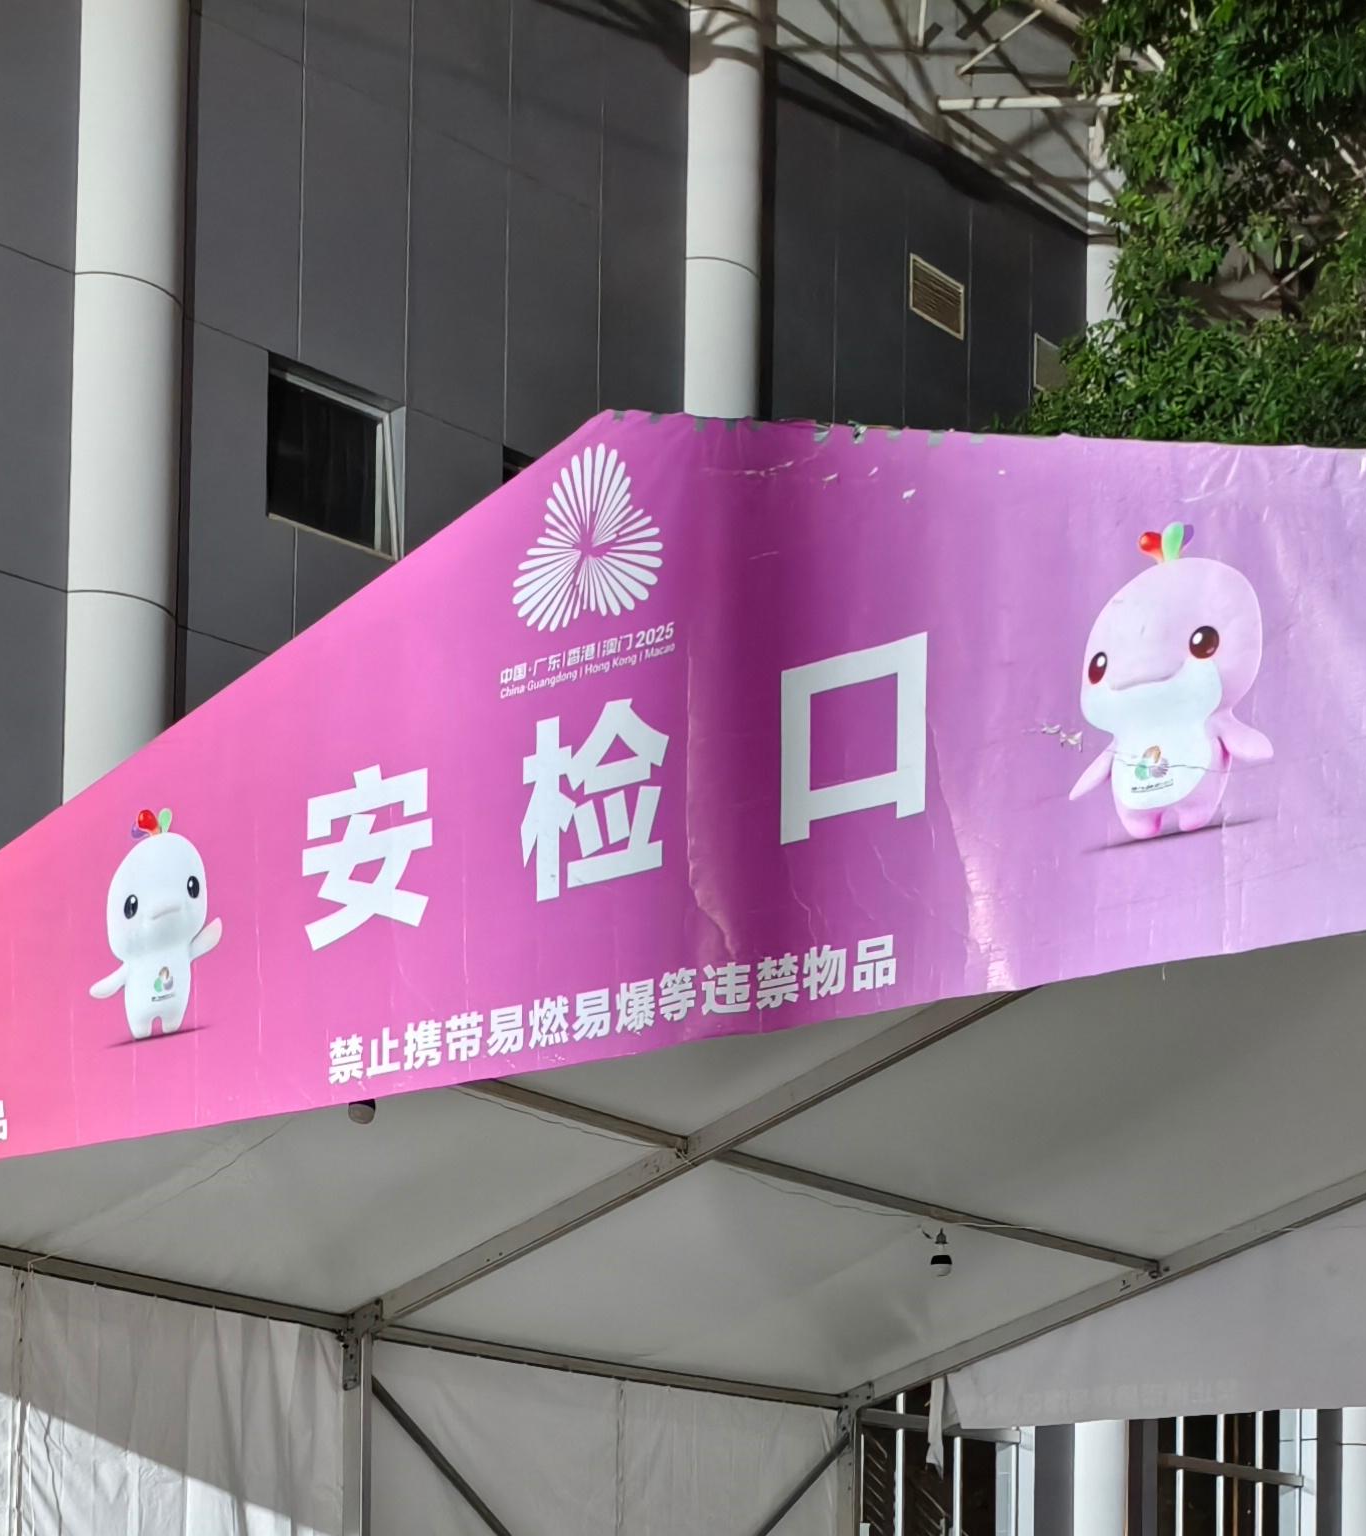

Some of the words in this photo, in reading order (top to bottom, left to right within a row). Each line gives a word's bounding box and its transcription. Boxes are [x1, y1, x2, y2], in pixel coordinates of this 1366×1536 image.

[585, 661, 610, 677] Hong
[612, 653, 637, 669] Kong
[644, 643, 676, 661] Macao
[635, 621, 675, 649] 2025
[302, 632, 928, 951] 安检口
[327, 934, 898, 1085] 禁止携带易燃易爆等违禁物品
